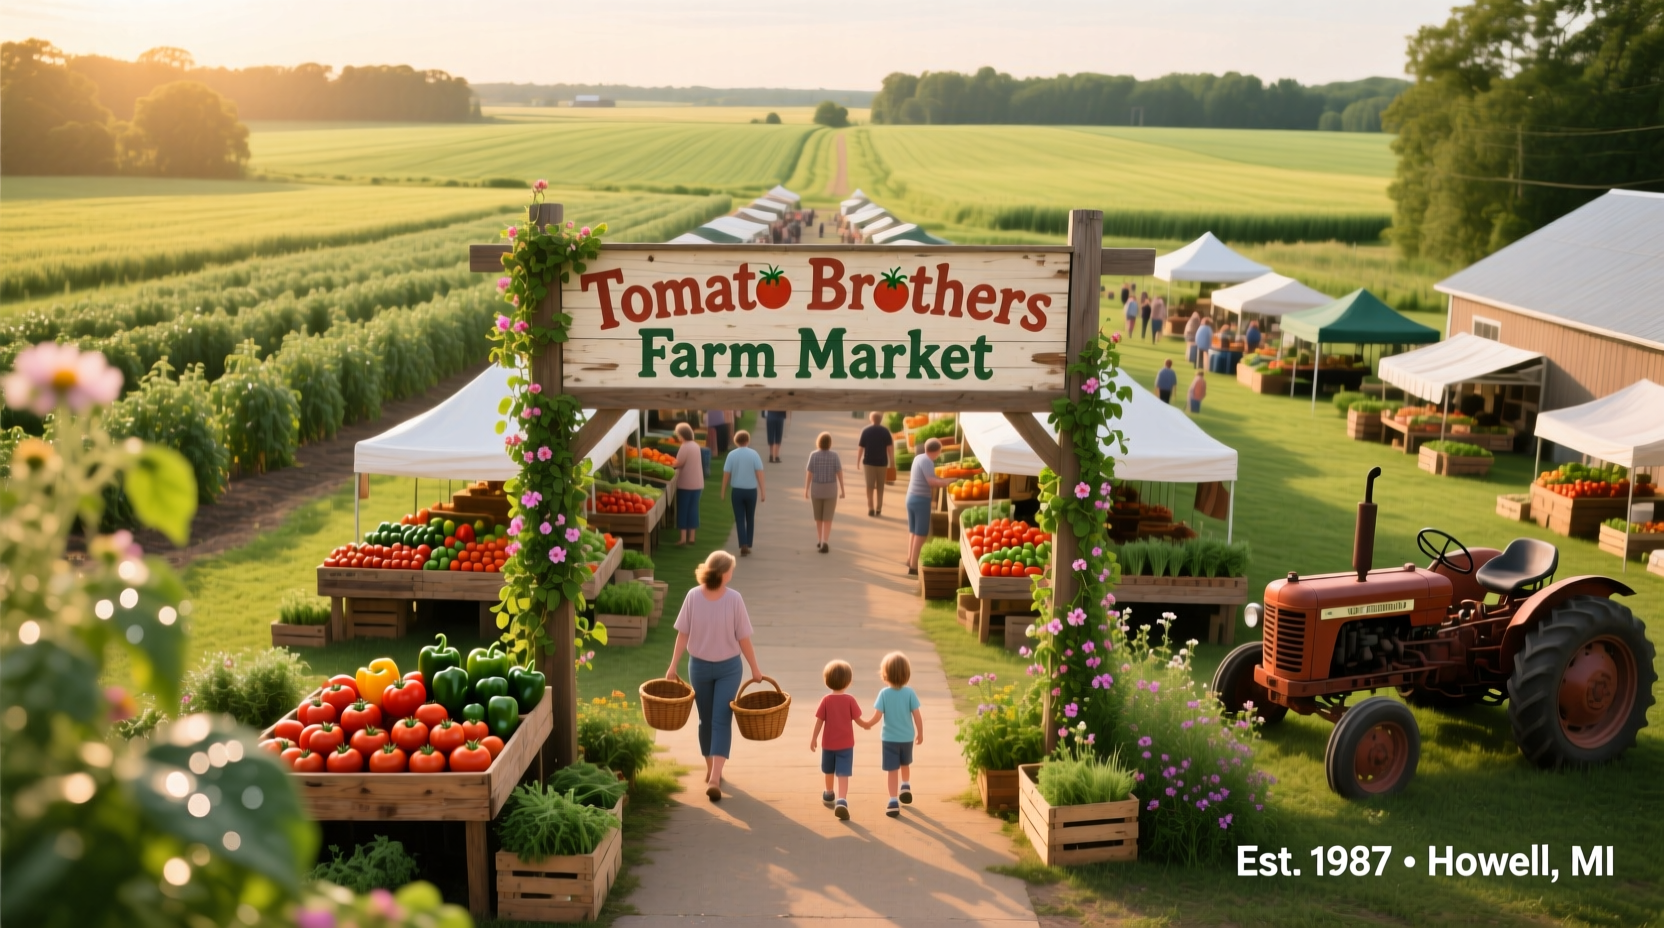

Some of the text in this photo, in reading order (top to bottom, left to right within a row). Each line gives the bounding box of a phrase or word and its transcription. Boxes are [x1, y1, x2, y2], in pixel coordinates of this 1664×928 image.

[580, 257, 1052, 333] Tomato Brothers
[637, 327, 994, 381] Farm Market
